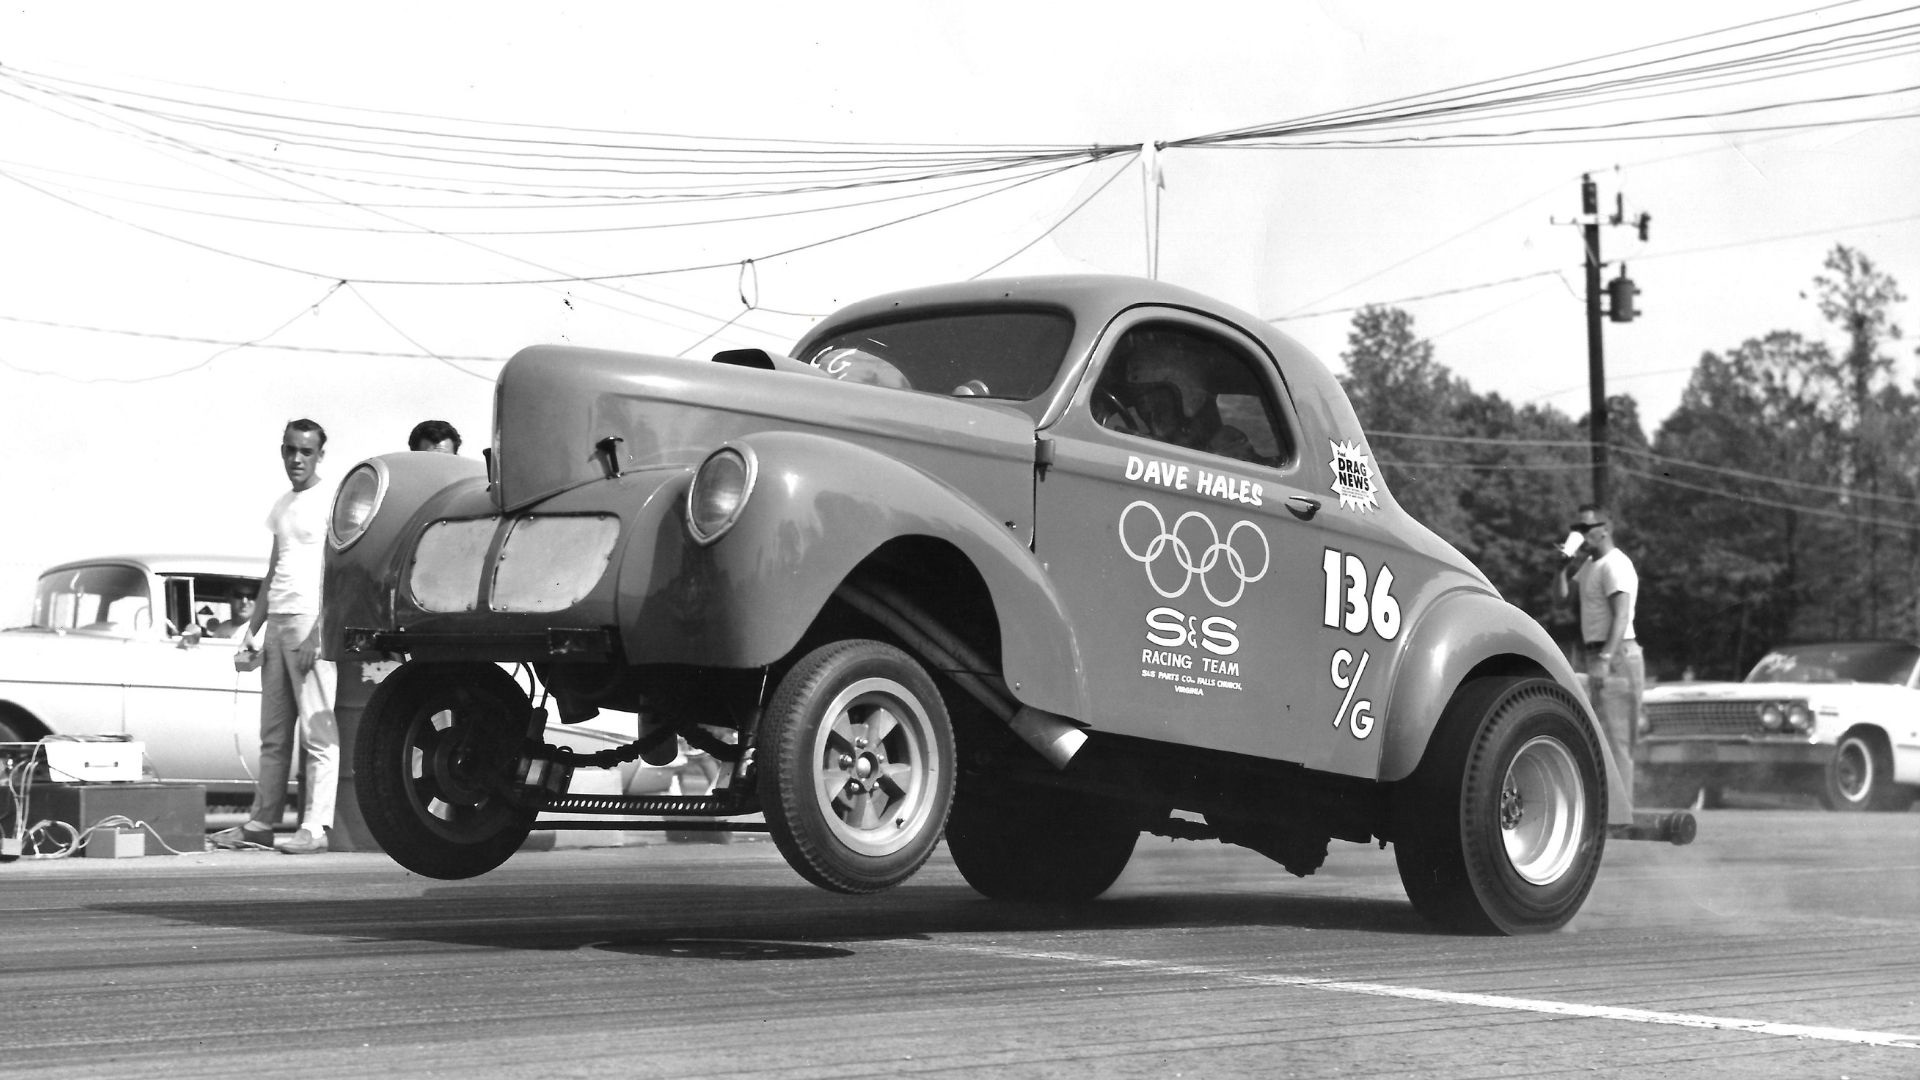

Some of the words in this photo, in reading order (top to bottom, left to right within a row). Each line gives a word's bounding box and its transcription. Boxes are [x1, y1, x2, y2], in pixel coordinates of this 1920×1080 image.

[1338, 457, 1367, 477] DRAG
[1125, 455, 1190, 490] DAVE
[1196, 470, 1263, 506] HALES
[1338, 471, 1370, 491] NEWS
[1323, 547, 1401, 640] 136
[1142, 648, 1193, 669] RACING
[1202, 657, 1240, 677] TEAM
[1158, 671, 1180, 682] PARTS
[1196, 677, 1216, 687] FALLS
[1174, 685, 1204, 696] VIRGINIA
